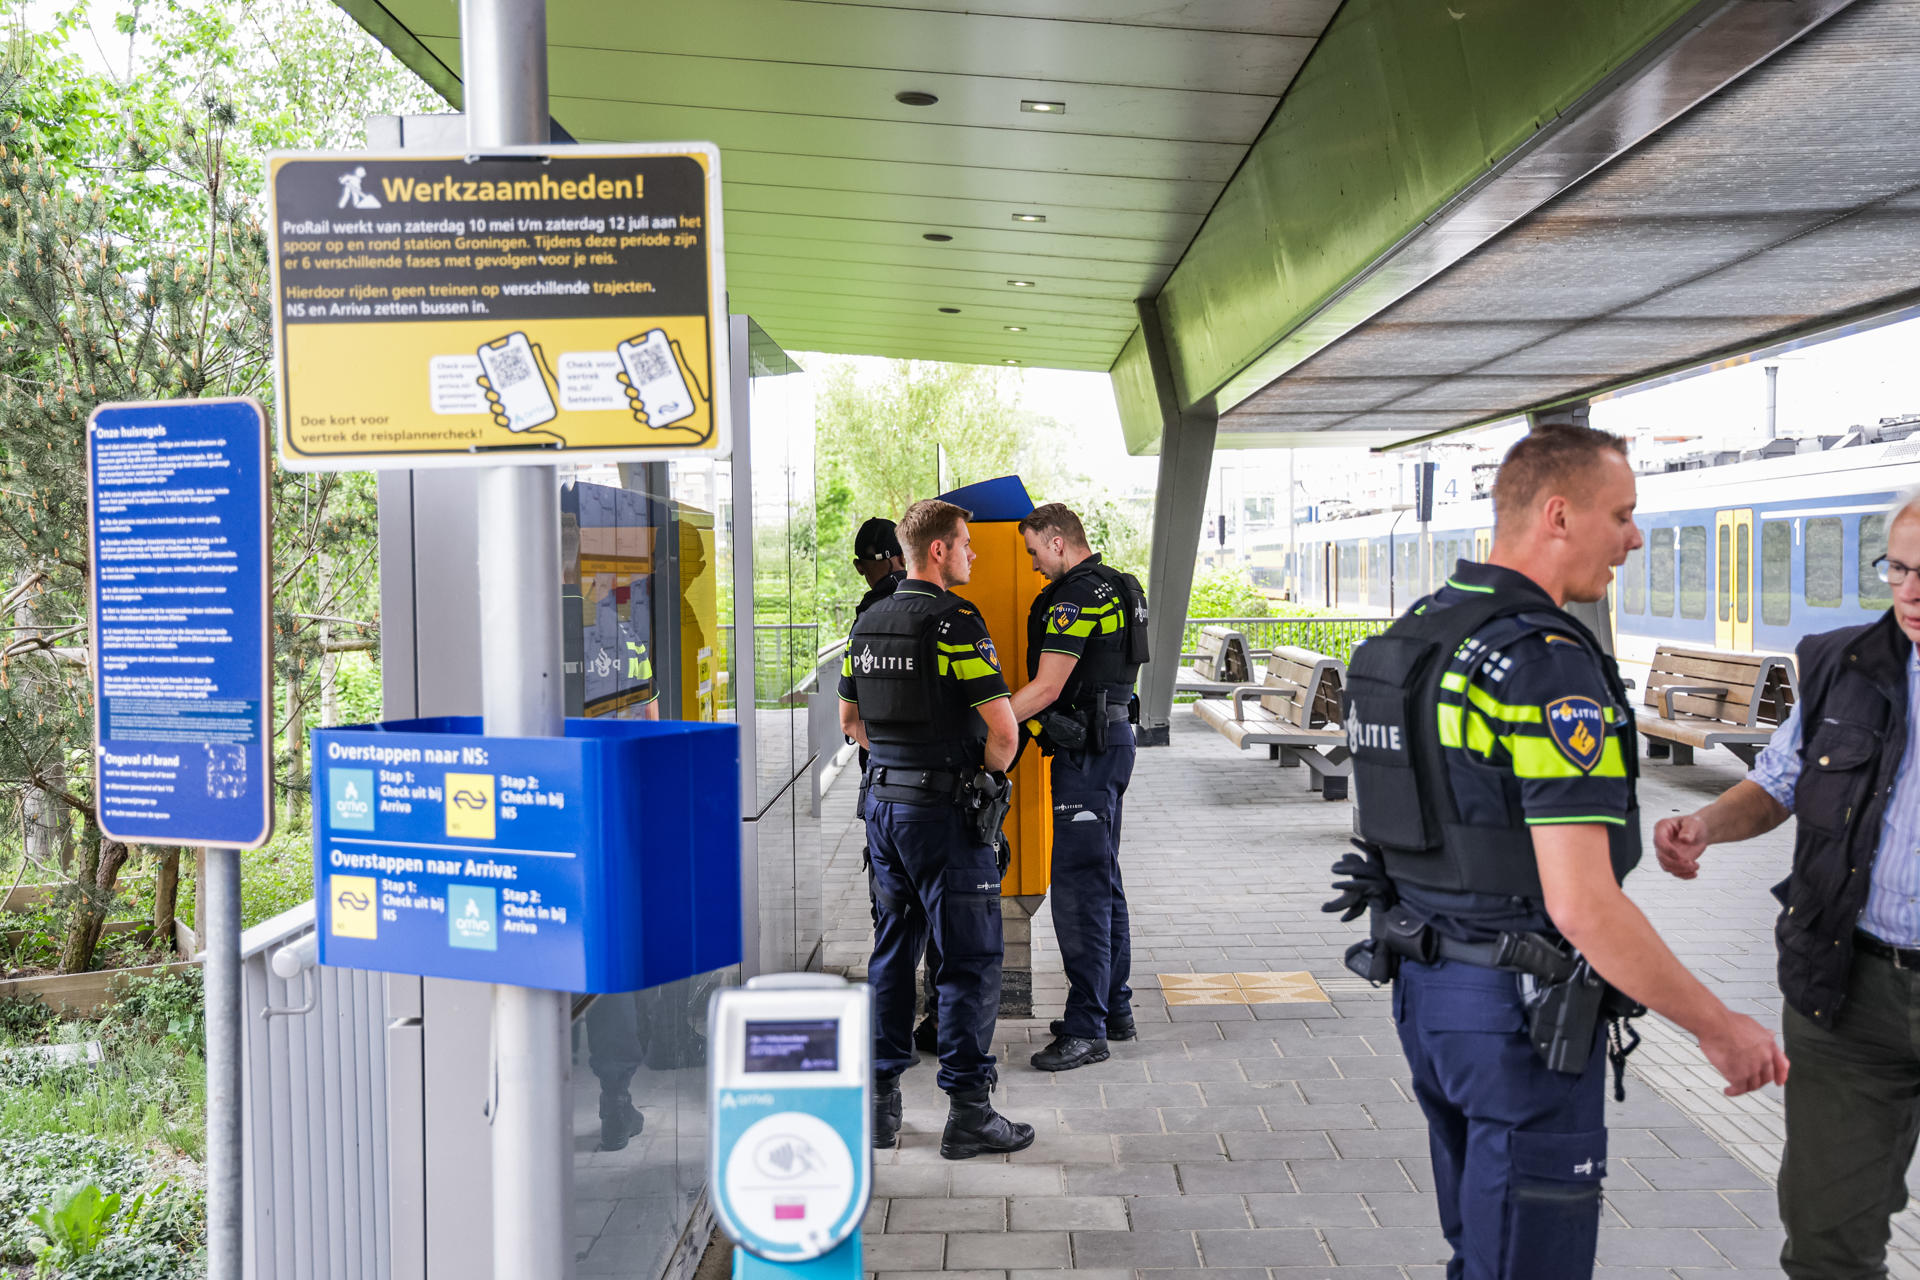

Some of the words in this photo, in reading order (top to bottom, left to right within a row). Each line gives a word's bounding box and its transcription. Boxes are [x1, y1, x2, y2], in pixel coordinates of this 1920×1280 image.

[382, 173, 644, 203] Werkzaamheden!
[282, 220, 330, 235] ProRail
[332, 220, 374, 234] werkt
[376, 222, 402, 234] van
[405, 219, 465, 236] zaterdag
[469, 218, 486, 232] 10
[489, 217, 515, 232] mei
[517, 218, 543, 232] t/m
[545, 216, 605, 233] zaterdag
[609, 216, 626, 230] 12
[627, 215, 649, 233] juli
[652, 217, 677, 230] aan
[679, 214, 701, 229] het
[283, 240, 322, 254] spoor
[325, 240, 344, 254] op
[347, 241, 365, 252] en
[368, 237, 401, 251] rond
[404, 237, 451, 251] station
[454, 235, 531, 252] Groningen.
[534, 234, 582, 251] Tijdens
[585, 233, 617, 248] deze
[620, 232, 671, 250] periode
[674, 232, 697, 249] zijn
[284, 259, 298, 270] er
[301, 256, 311, 270] 6
[314, 255, 402, 270] verschillende
[406, 254, 441, 269] fases
[444, 255, 471, 268] met
[475, 253, 537, 270] gevolgen
[541, 254, 571, 266] voor
[573, 251, 587, 269] je
[590, 251, 617, 266] reis.
[285, 284, 346, 299] Hierdoor
[349, 284, 389, 301] rijden
[392, 285, 426, 301] geen
[429, 282, 479, 297] treinen
[481, 284, 500, 299] op
[502, 280, 590, 297] verschillende
[593, 279, 656, 297] trajecten.
[286, 302, 306, 317] NS
[308, 305, 327, 317] en
[330, 302, 371, 317] Arriva
[374, 303, 418, 316] zetten
[420, 300, 469, 315] bussen
[472, 299, 490, 314] in.
[300, 415, 326, 427] Doe
[330, 415, 356, 425] kort
[360, 415, 390, 425] voor
[96, 427, 120, 439] Onze
[120, 424, 167, 440] huisregels
[301, 431, 347, 443] vertrek
[351, 431, 367, 442] de
[370, 429, 483, 444] reisplannercheck!
[1444, 478, 1459, 498] 4
[1673, 526, 1681, 550] 2
[1793, 518, 1801, 546] 1
[853, 644, 914, 674] POLITIE
[1551, 702, 1600, 722] POLITIE
[105, 752, 141, 767] Ongeval
[142, 754, 152, 766] of
[153, 754, 180, 767] brand
[328, 742, 421, 765] Overstappen
[424, 749, 459, 764] naar
[462, 747, 489, 766] NS:
[379, 769, 404, 785] Stap
[405, 771, 416, 783] 1:
[500, 774, 527, 791] Stap
[527, 776, 540, 789] 2:
[379, 785, 411, 799] Check
[412, 786, 427, 799] uit
[429, 787, 443, 803] bij
[501, 790, 535, 806] Check
[535, 792, 548, 806] in
[549, 792, 565, 810] bij
[379, 800, 412, 814] Arriva
[501, 806, 518, 820] NS
[330, 850, 424, 875] Overstappen
[426, 859, 462, 876] naar
[465, 858, 518, 881] Arriva:
[381, 878, 406, 894] Stap
[407, 880, 417, 894] 1:
[382, 894, 413, 908] Check
[414, 895, 429, 909] uit
[430, 897, 446, 914] bij
[502, 888, 529, 904] Stap
[529, 889, 542, 904] 2:
[382, 909, 398, 922] NS
[503, 904, 537, 919] Check
[537, 905, 550, 919] in
[551, 906, 567, 924] bij
[503, 919, 539, 935] Arriva
